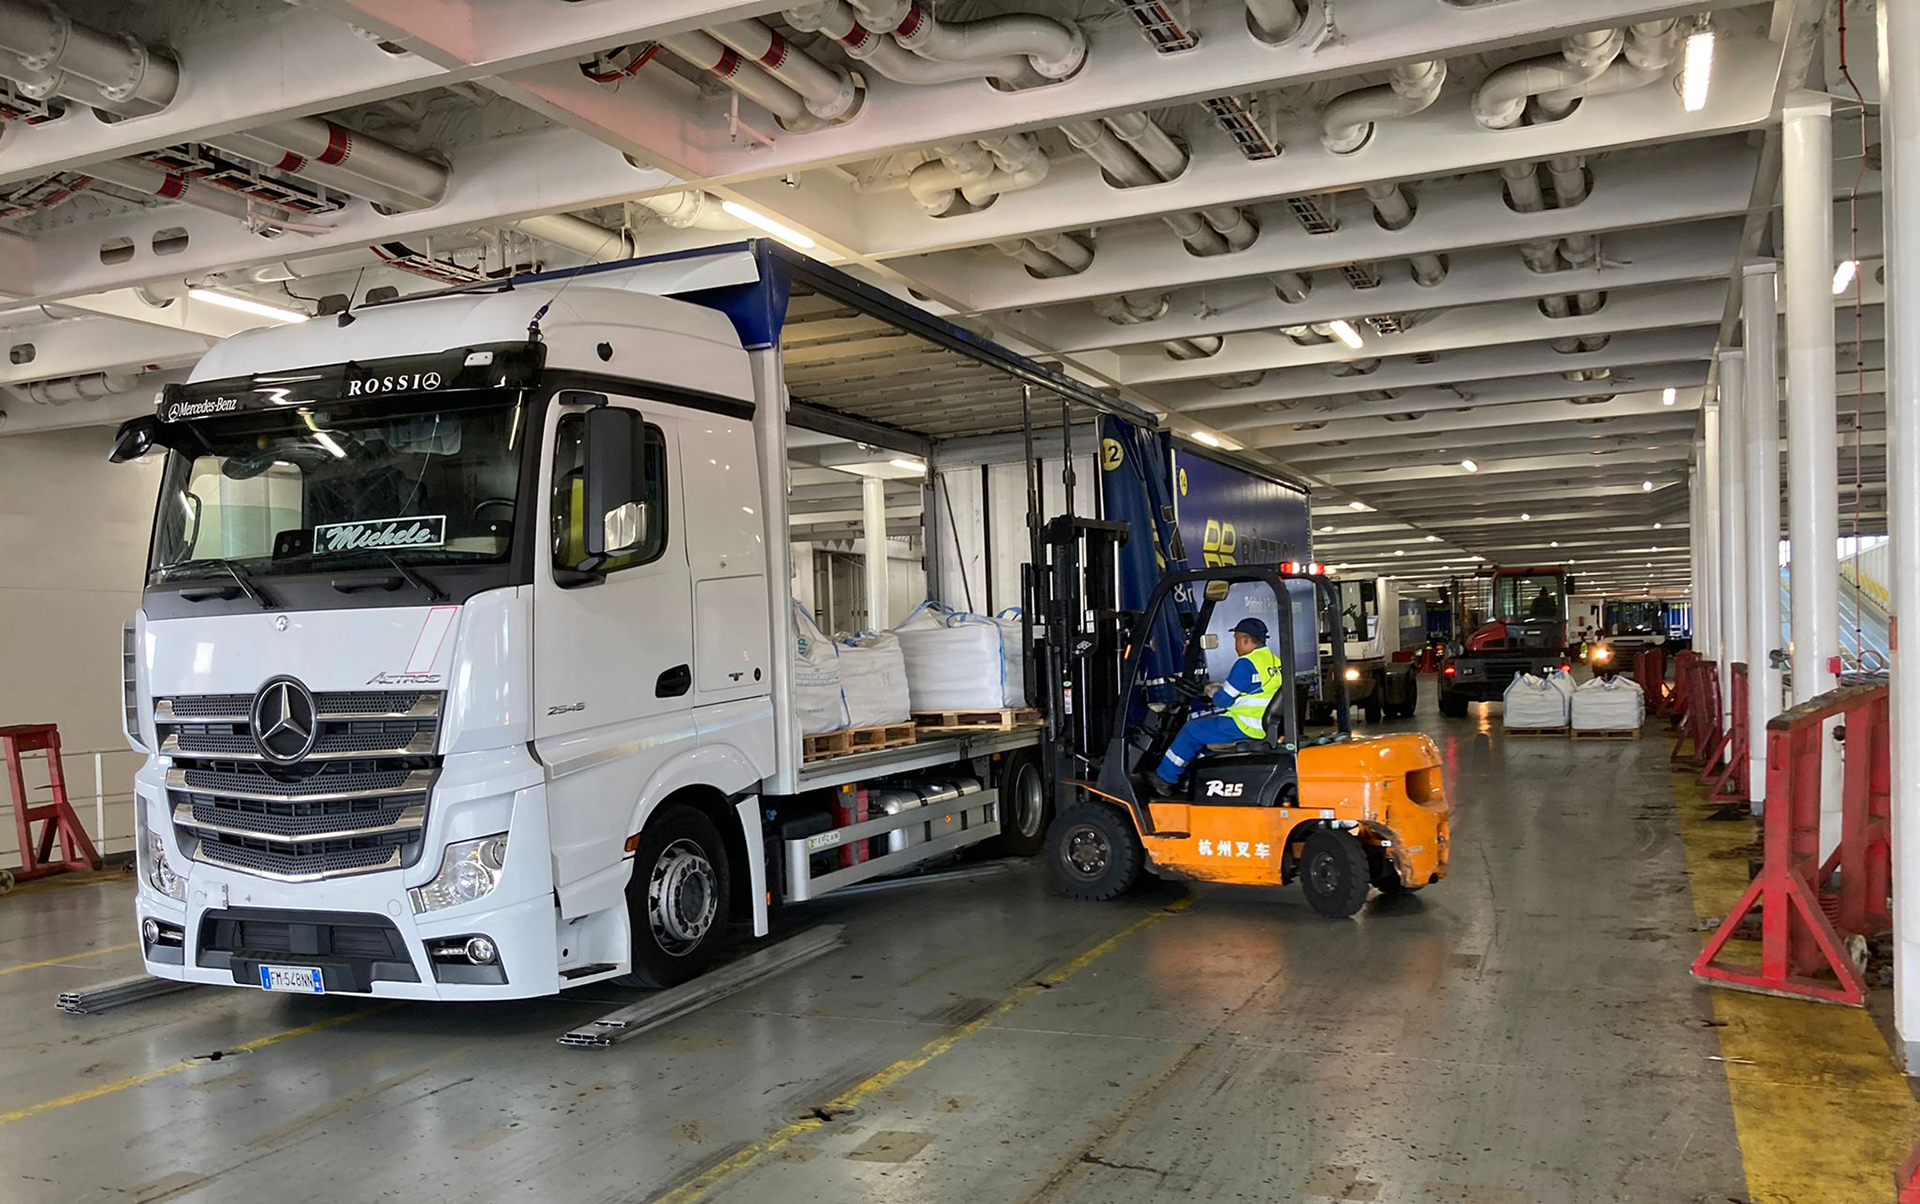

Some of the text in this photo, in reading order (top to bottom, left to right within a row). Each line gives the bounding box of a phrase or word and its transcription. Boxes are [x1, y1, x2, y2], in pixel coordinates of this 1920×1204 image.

[348, 373, 420, 396] ROSSI
[178, 397, 237, 417] Mercedes-Benz
[326, 522, 431, 550] Michele
[366, 671, 441, 685] ACTROS
[548, 702, 585, 715] 2545
[1205, 780, 1243, 797] R25
[1198, 839, 1270, 859] 杭州叉车
